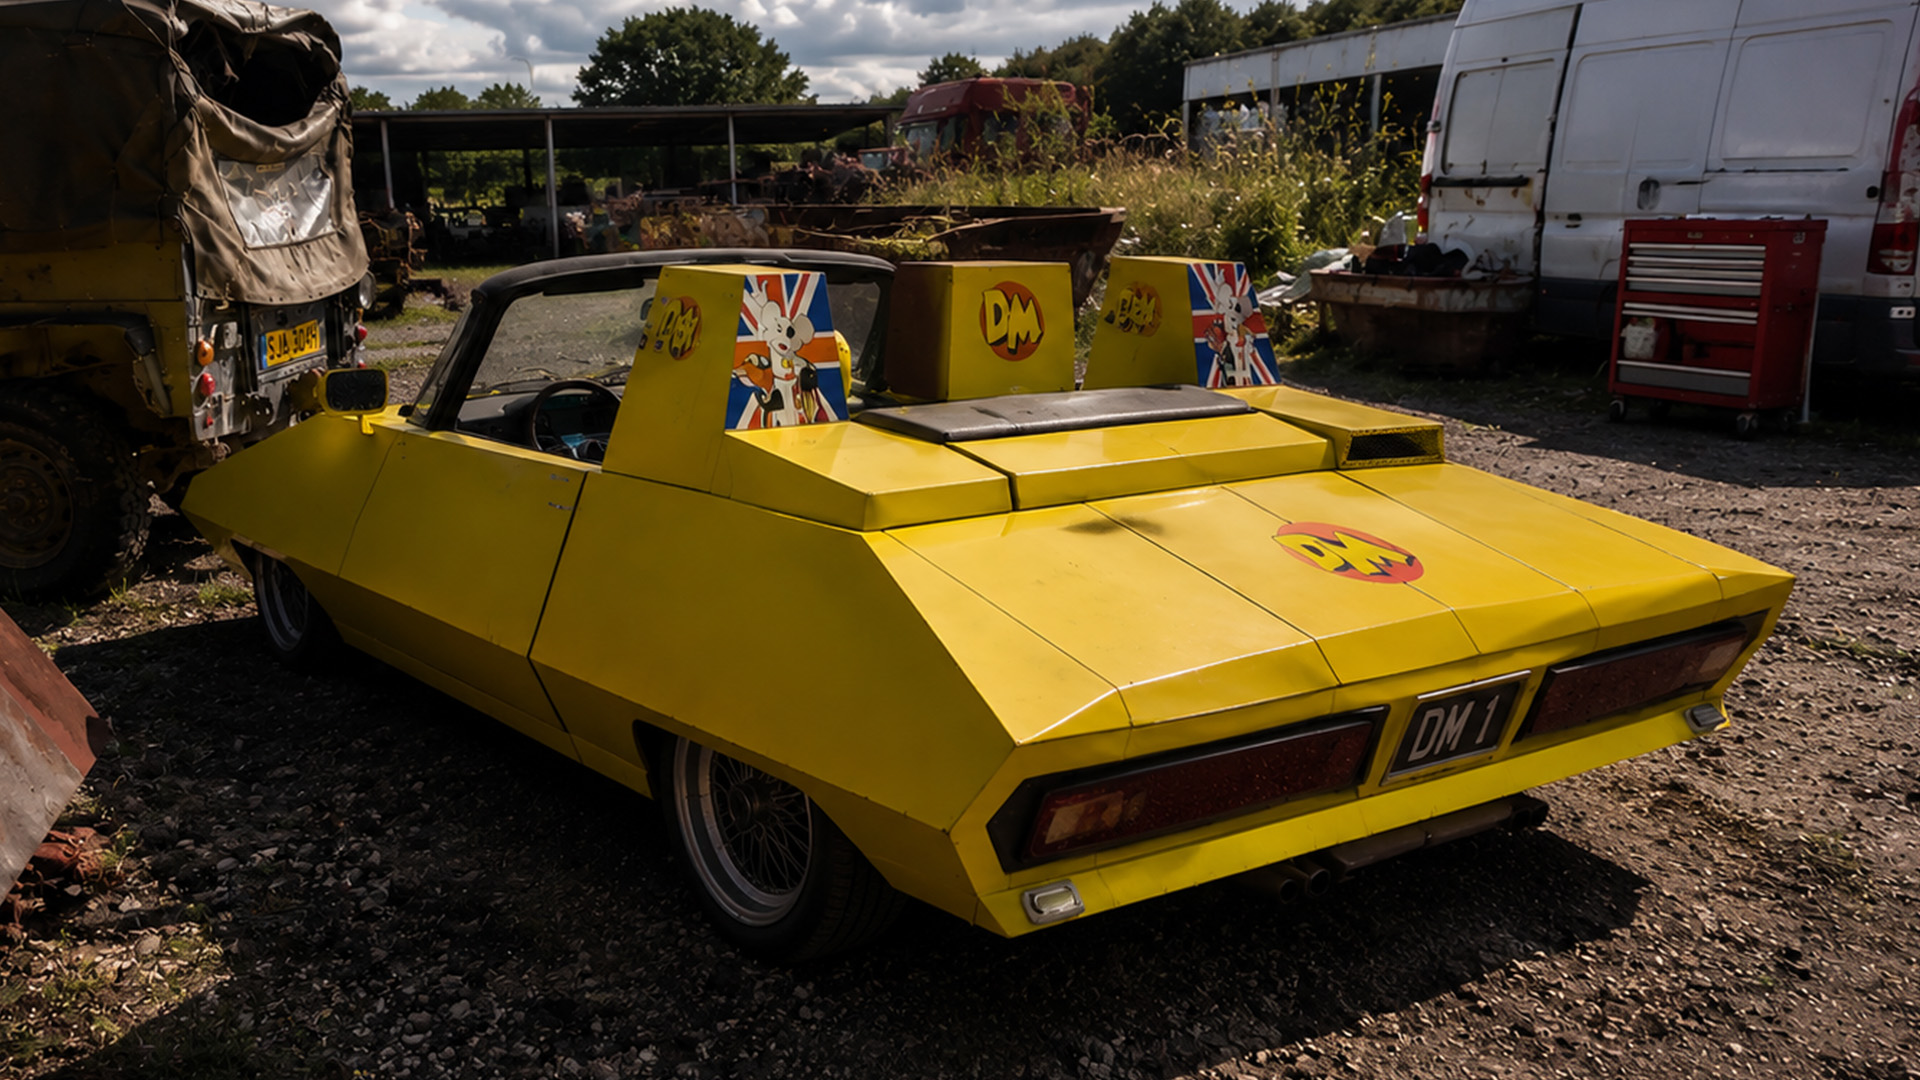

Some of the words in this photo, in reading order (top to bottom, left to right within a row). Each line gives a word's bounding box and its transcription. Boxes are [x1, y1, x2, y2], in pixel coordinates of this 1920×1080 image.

[983, 288, 1043, 355] DM
[1272, 531, 1415, 576] DM
[1408, 701, 1475, 762] DM
[1475, 695, 1499, 744] 1
